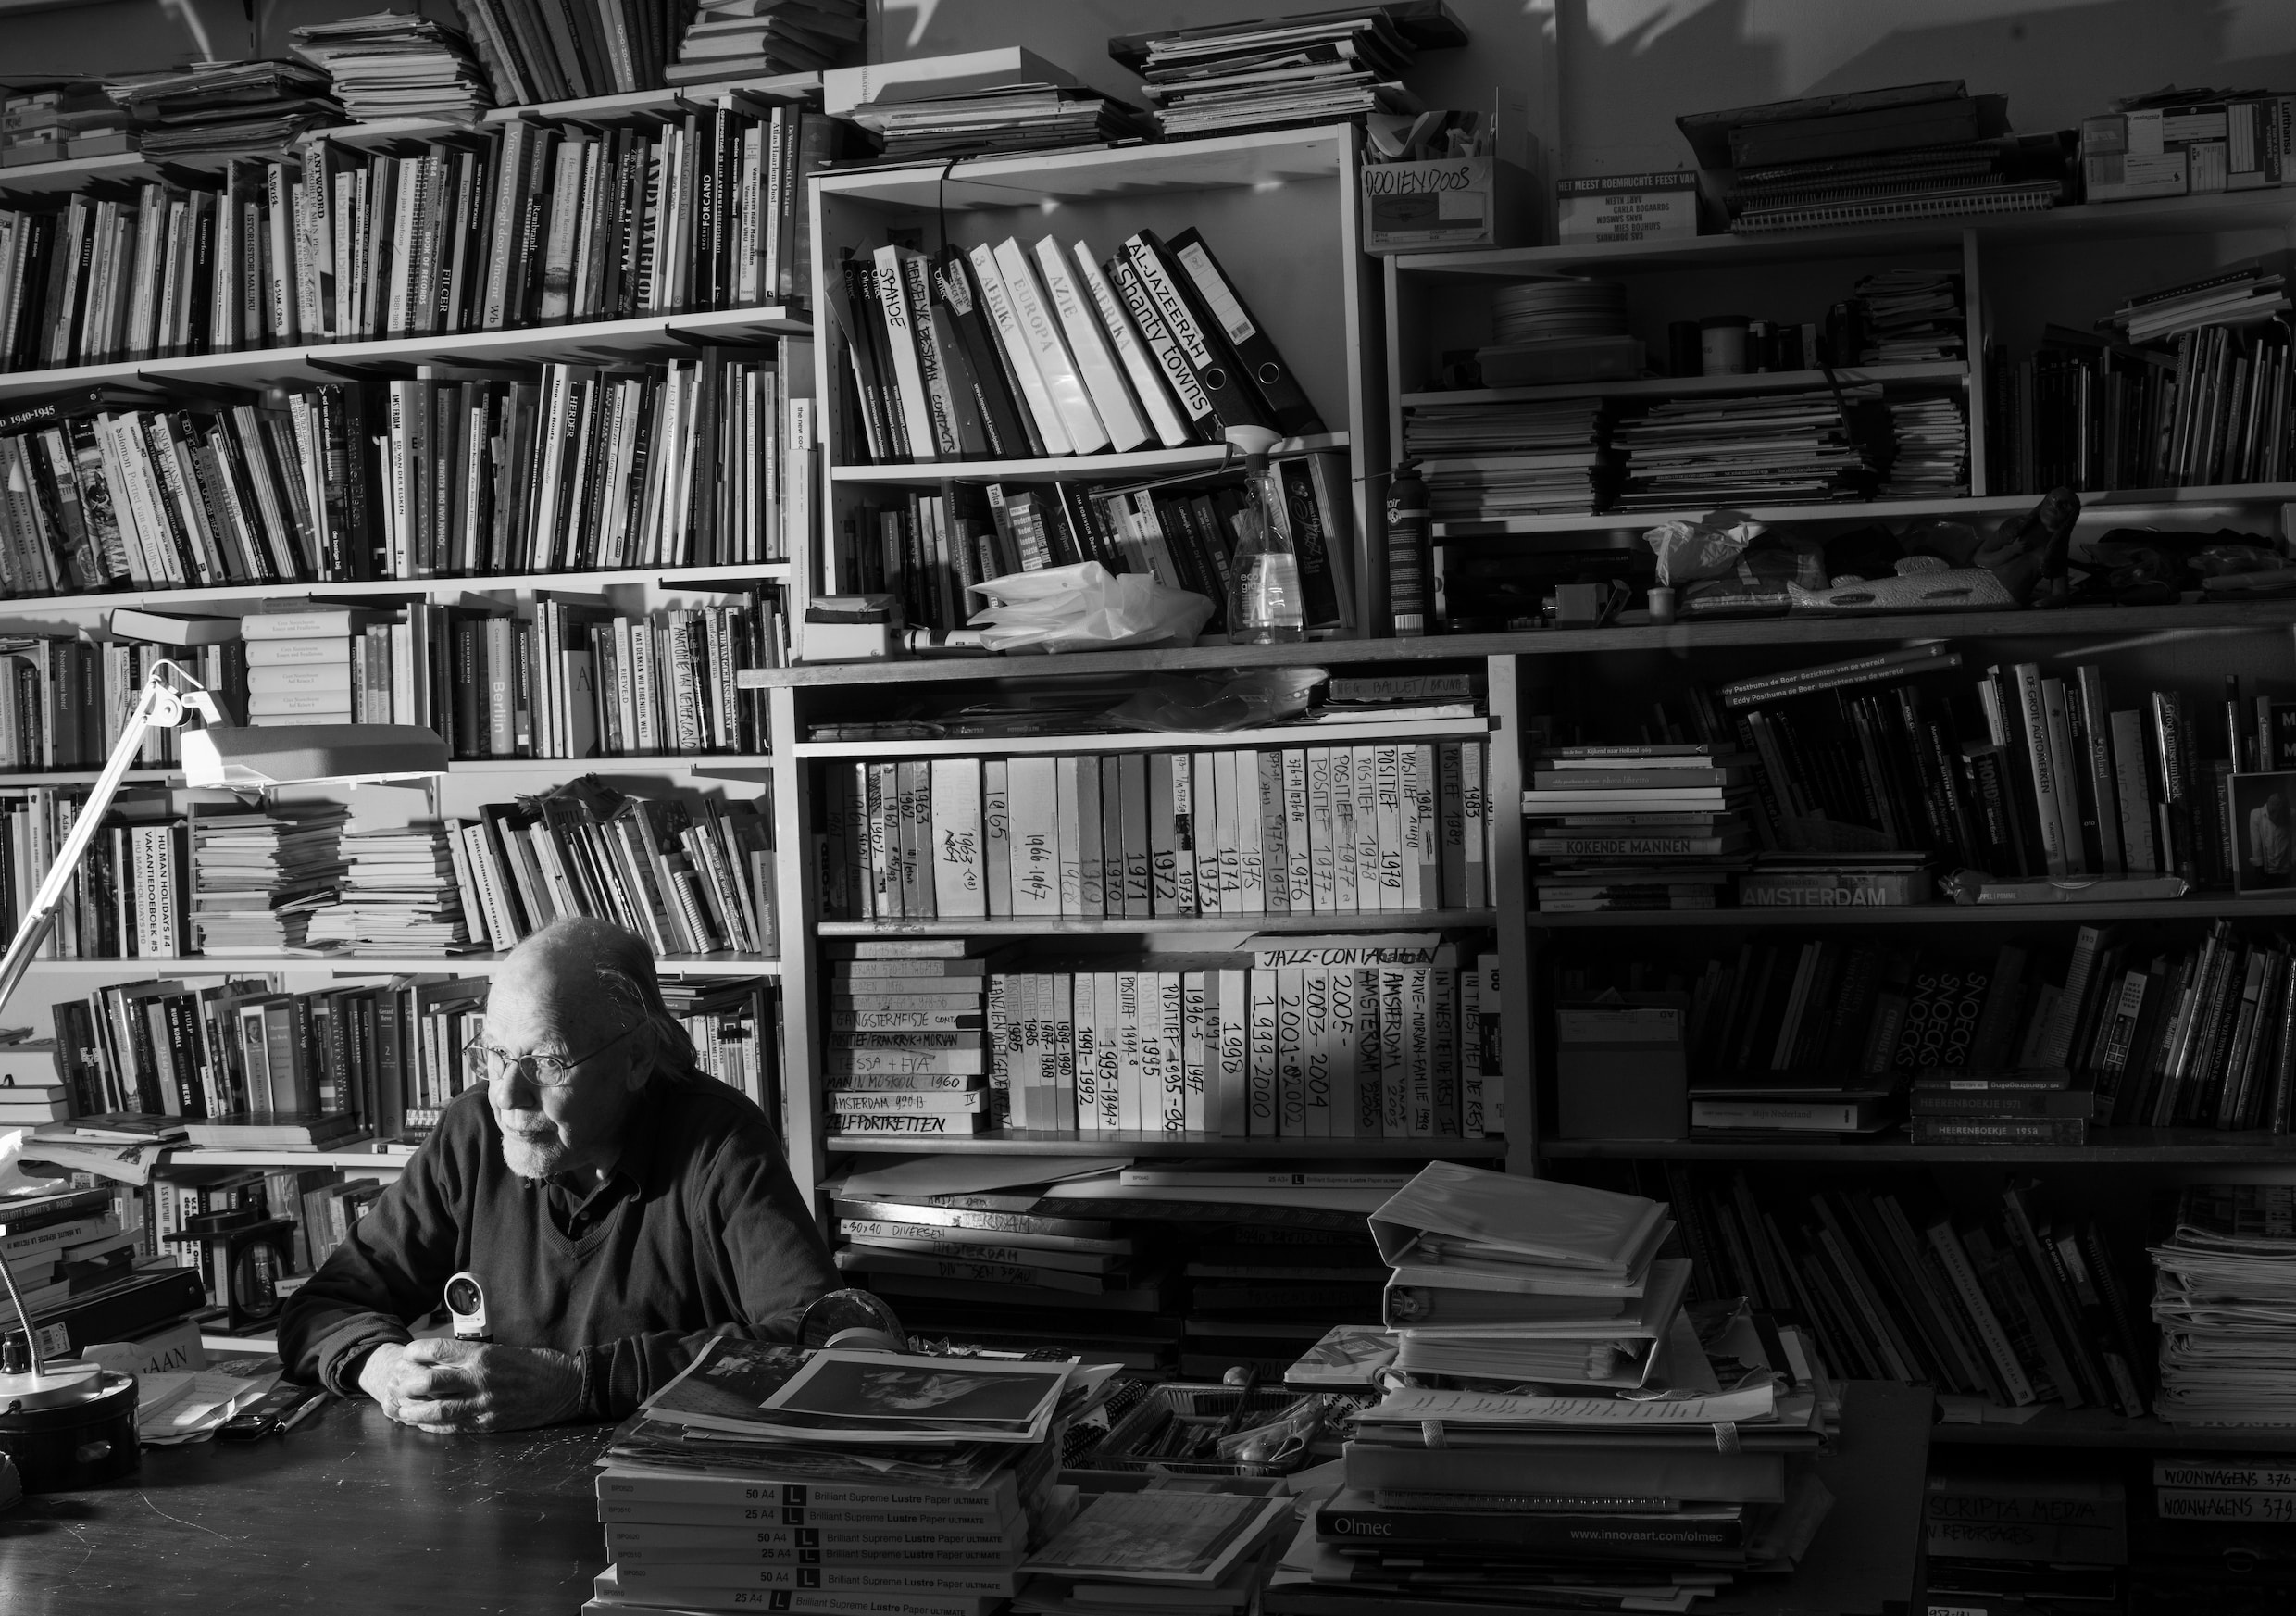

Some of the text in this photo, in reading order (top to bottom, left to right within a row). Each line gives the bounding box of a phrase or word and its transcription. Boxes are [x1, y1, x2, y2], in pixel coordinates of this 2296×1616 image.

[2282, 102, 2291, 155] Lufthansa
[430, 157, 438, 177] 1984
[771, 144, 780, 184] Haarlem
[314, 153, 324, 218] ANTWOORD
[1558, 174, 1695, 192] HET MEEST ROEMRUCHTE FEEST VAN
[703, 175, 711, 226] FORCANO
[1606, 196, 1624, 205] KLEIN
[1614, 203, 1669, 213] CARLA BOGAARDS
[1597, 214, 1642, 224] HANS SAMSON
[1633, 222, 1660, 231] BOUHUYS
[423, 257, 429, 266] OF
[419, 270, 429, 305] RECORDS
[974, 255, 1015, 334] 3 AFRIKA
[1128, 242, 1206, 359] AL-JAZEERAH
[1014, 278, 1054, 353] EUROPA
[1084, 271, 1130, 353] AMERIKA
[1114, 268, 1210, 412] Shanty towns
[10, 406, 55, 424] 1940-1945
[393, 395, 401, 428] AMSTERDAM
[567, 395, 578, 437] HERDER
[397, 441, 402, 449] ED
[620, 669, 629, 703] RIETVELD
[1733, 695, 1750, 705] Eddy
[1752, 690, 1787, 702] Posthuma
[1798, 684, 1816, 694] Boer
[1819, 677, 1853, 689] Gezichten
[1854, 675, 1867, 683] van
[1868, 672, 1878, 681] de
[1878, 668, 1903, 679] wereld
[493, 682, 506, 733] Berlijn
[2026, 676, 2050, 794] DE GROTE AUTOMERKEN
[2096, 745, 2108, 779] Opland
[1334, 755, 1354, 823] POSITIEF
[1602, 775, 1649, 785] photo libretto
[884, 796, 897, 829] 1962
[900, 791, 913, 820] 1962
[915, 787, 929, 824] 1963
[1357, 758, 1377, 881] POSITIEF 1978
[1378, 749, 1401, 888] POSITIEF 1979
[1417, 790, 1432, 823] 1981
[1465, 787, 1481, 818] 1983
[1567, 840, 1691, 854] KOKENDE MANNEN
[1062, 861, 1080, 905] 1968
[1081, 859, 1103, 903] 1969
[1105, 858, 1122, 902] 1970
[1126, 853, 1147, 900] 1971
[1154, 850, 1176, 899] 1972
[1199, 856, 1218, 907] 1973
[1219, 848, 1240, 892] 1974
[1242, 847, 1262, 891] 1975
[1290, 853, 1311, 900] 1976
[144, 832, 158, 952] VAKANTIEDOEBOEK #5
[158, 835, 171, 947] HU.MAN HOLIDAYS #4
[1742, 887, 1886, 909] AMSTERDAM
[1024, 1018, 1039, 1046] 1986
[1896, 974, 1937, 1066] SNOECKS
[1919, 973, 1960, 1067] SNOECKS
[1945, 972, 1987, 1065] SNOECKS
[384, 1046, 391, 1056] 2
[1008, 1021, 1024, 1053] 1985
[1221, 1022, 1244, 1074] 1998
[837, 1057, 881, 1071] TESSA
[901, 1057, 930, 1072] EVA
[1142, 1037, 1160, 1077] 1995
[834, 1097, 889, 1110] AMSTERDAM
[1920, 1098, 2021, 1109] HEERENBOEKJE 1971
[824, 1114, 945, 1133] ZELFPORTRETTEN
[1939, 1127, 2007, 1135] HEERENBOEKJE
[1, 1199, 73, 1221] ELLIOTT ERWITT'S PARIS
[892, 1227, 945, 1238] DIVERSEN
[2165, 1469, 2258, 1487] WOONWAGENS
[746, 1489, 759, 1498] 50
[761, 1489, 775, 1499] A4
[815, 1492, 847, 1503] Brilliant
[849, 1493, 889, 1505] Supreme
[892, 1495, 922, 1504] Lustre
[925, 1495, 951, 1506] Paper
[1930, 1496, 2096, 1520] SCRIPTA MEDIA
[2164, 1496, 2252, 1518] WOONWAGENS
[745, 1510, 758, 1519] 25
[761, 1510, 774, 1519] A4
[810, 1511, 842, 1522] Brilliant
[844, 1513, 885, 1524] Supreme
[887, 1514, 917, 1523] Lustre
[919, 1515, 946, 1525] Paper
[948, 1516, 984, 1524] ULTIMATE
[1334, 1517, 1723, 1543] Olmec www.innovaart.com/olmec
